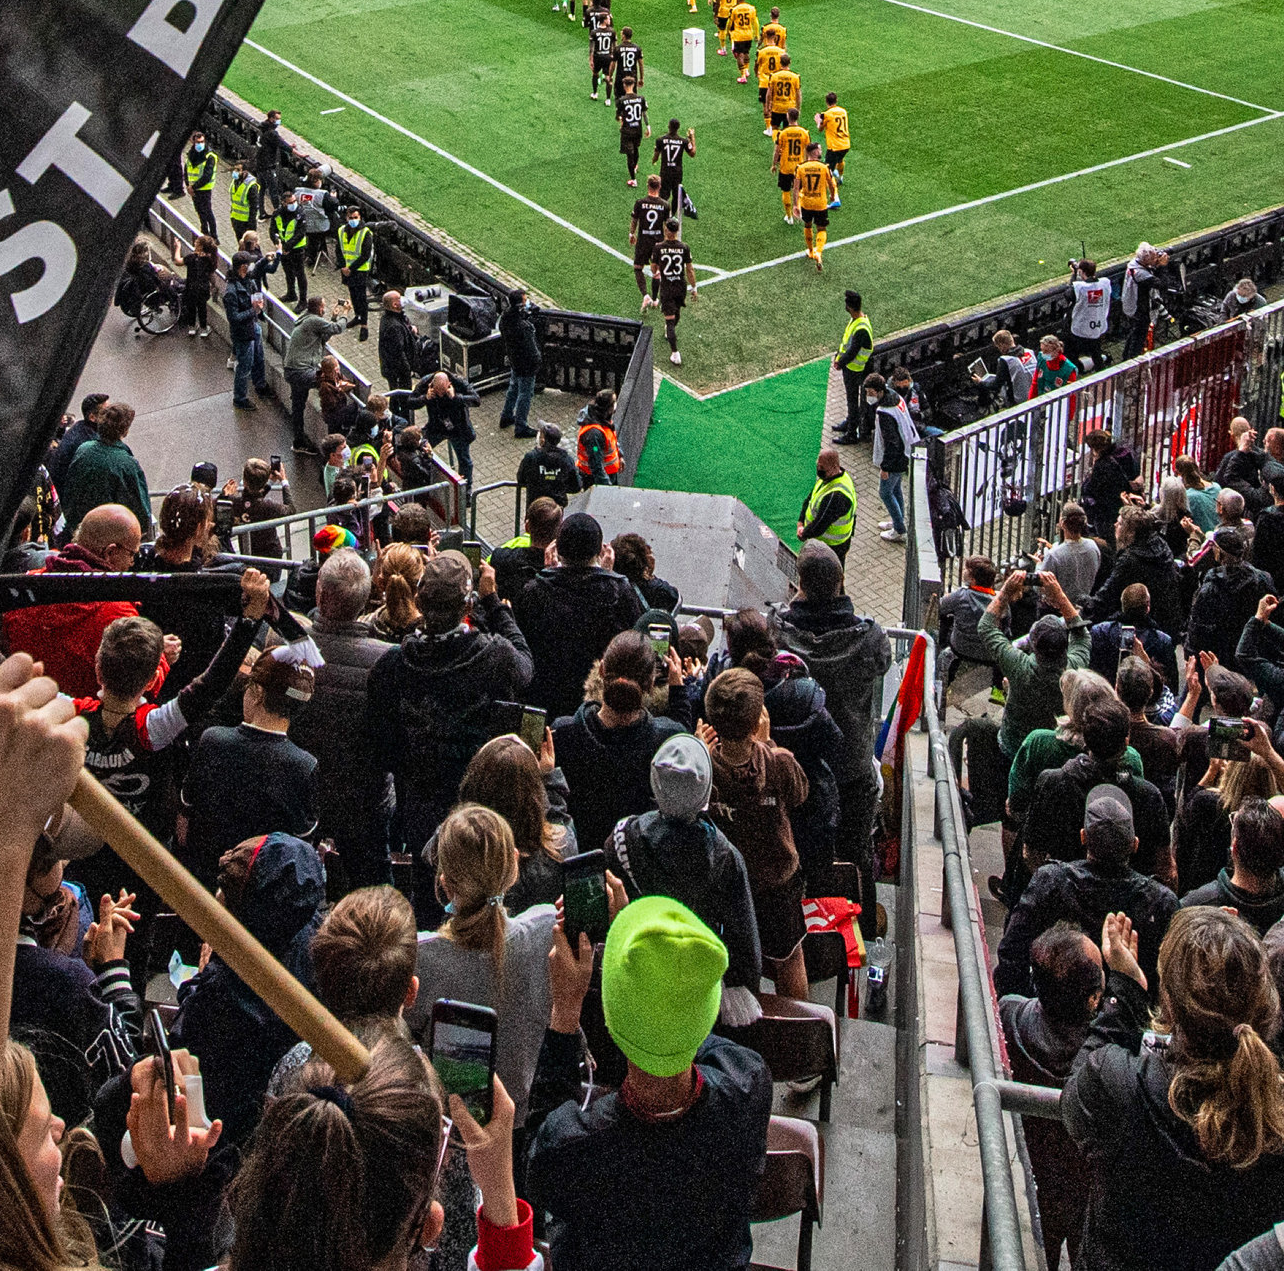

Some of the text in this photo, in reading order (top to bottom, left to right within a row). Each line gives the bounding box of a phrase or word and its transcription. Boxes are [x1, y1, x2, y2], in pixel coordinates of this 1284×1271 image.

[737, 13, 750, 26] 35
[597, 37, 611, 51] 10
[620, 52, 635, 67] 18
[768, 57, 776, 71] 8
[776, 82, 791, 97] 33
[625, 103, 642, 122] 30
[835, 116, 847, 133] 21
[664, 145, 680, 162] 17
[787, 139, 801, 156] 16
[805, 174, 821, 192] 17
[646, 210, 658, 230] 9
[661, 255, 683, 276] 23
[1089, 320, 1101, 330] 04
